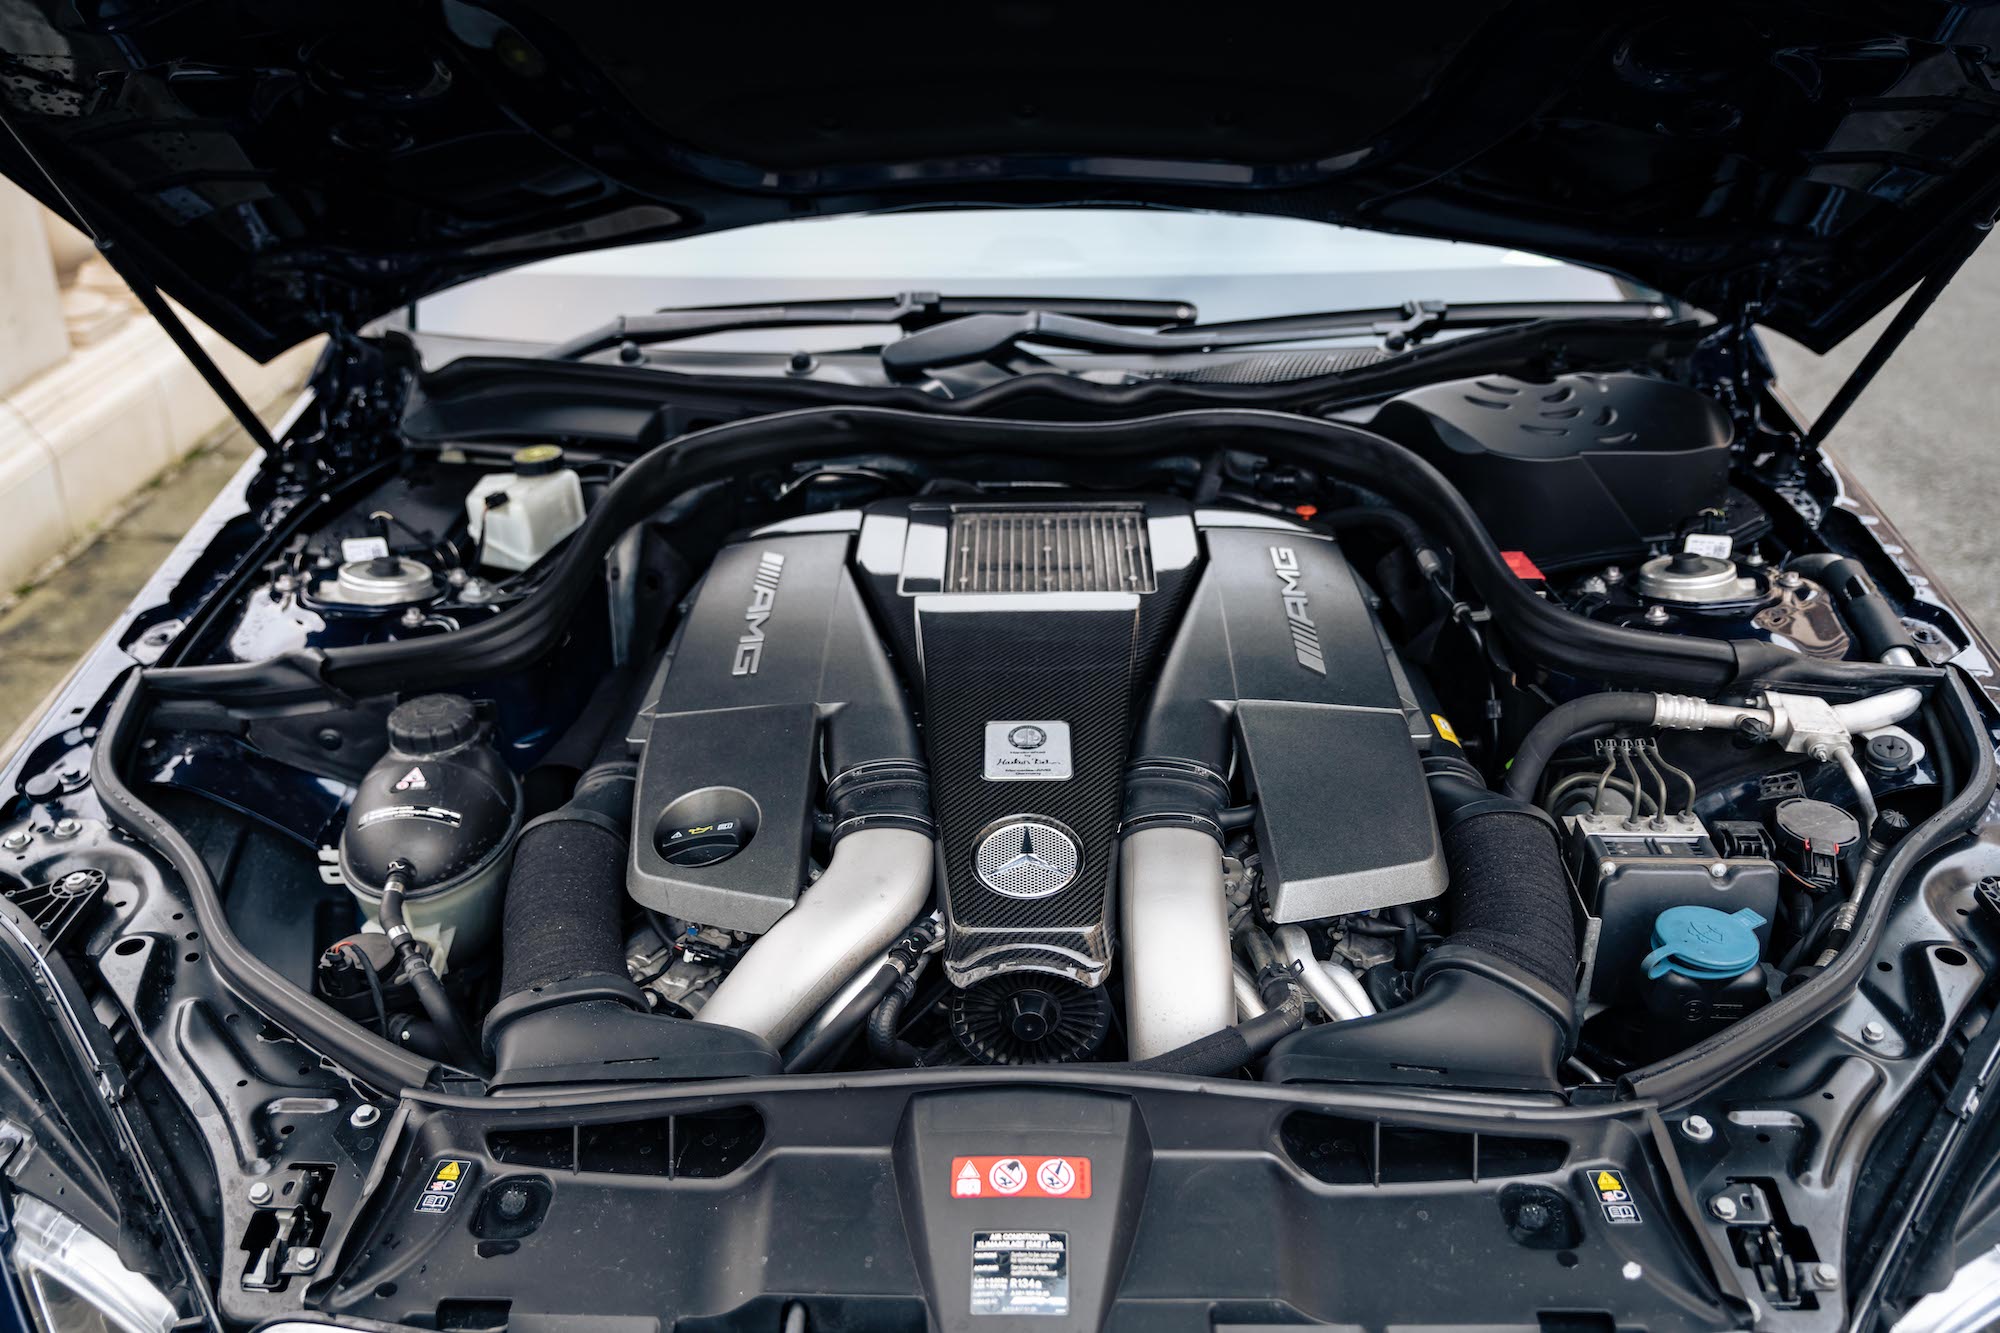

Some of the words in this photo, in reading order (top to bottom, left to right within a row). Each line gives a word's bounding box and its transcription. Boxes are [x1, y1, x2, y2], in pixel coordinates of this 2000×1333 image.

[1270, 546, 1316, 629] AMG
[732, 584, 777, 676] AMG
[1010, 1278, 1042, 1288] R134a
